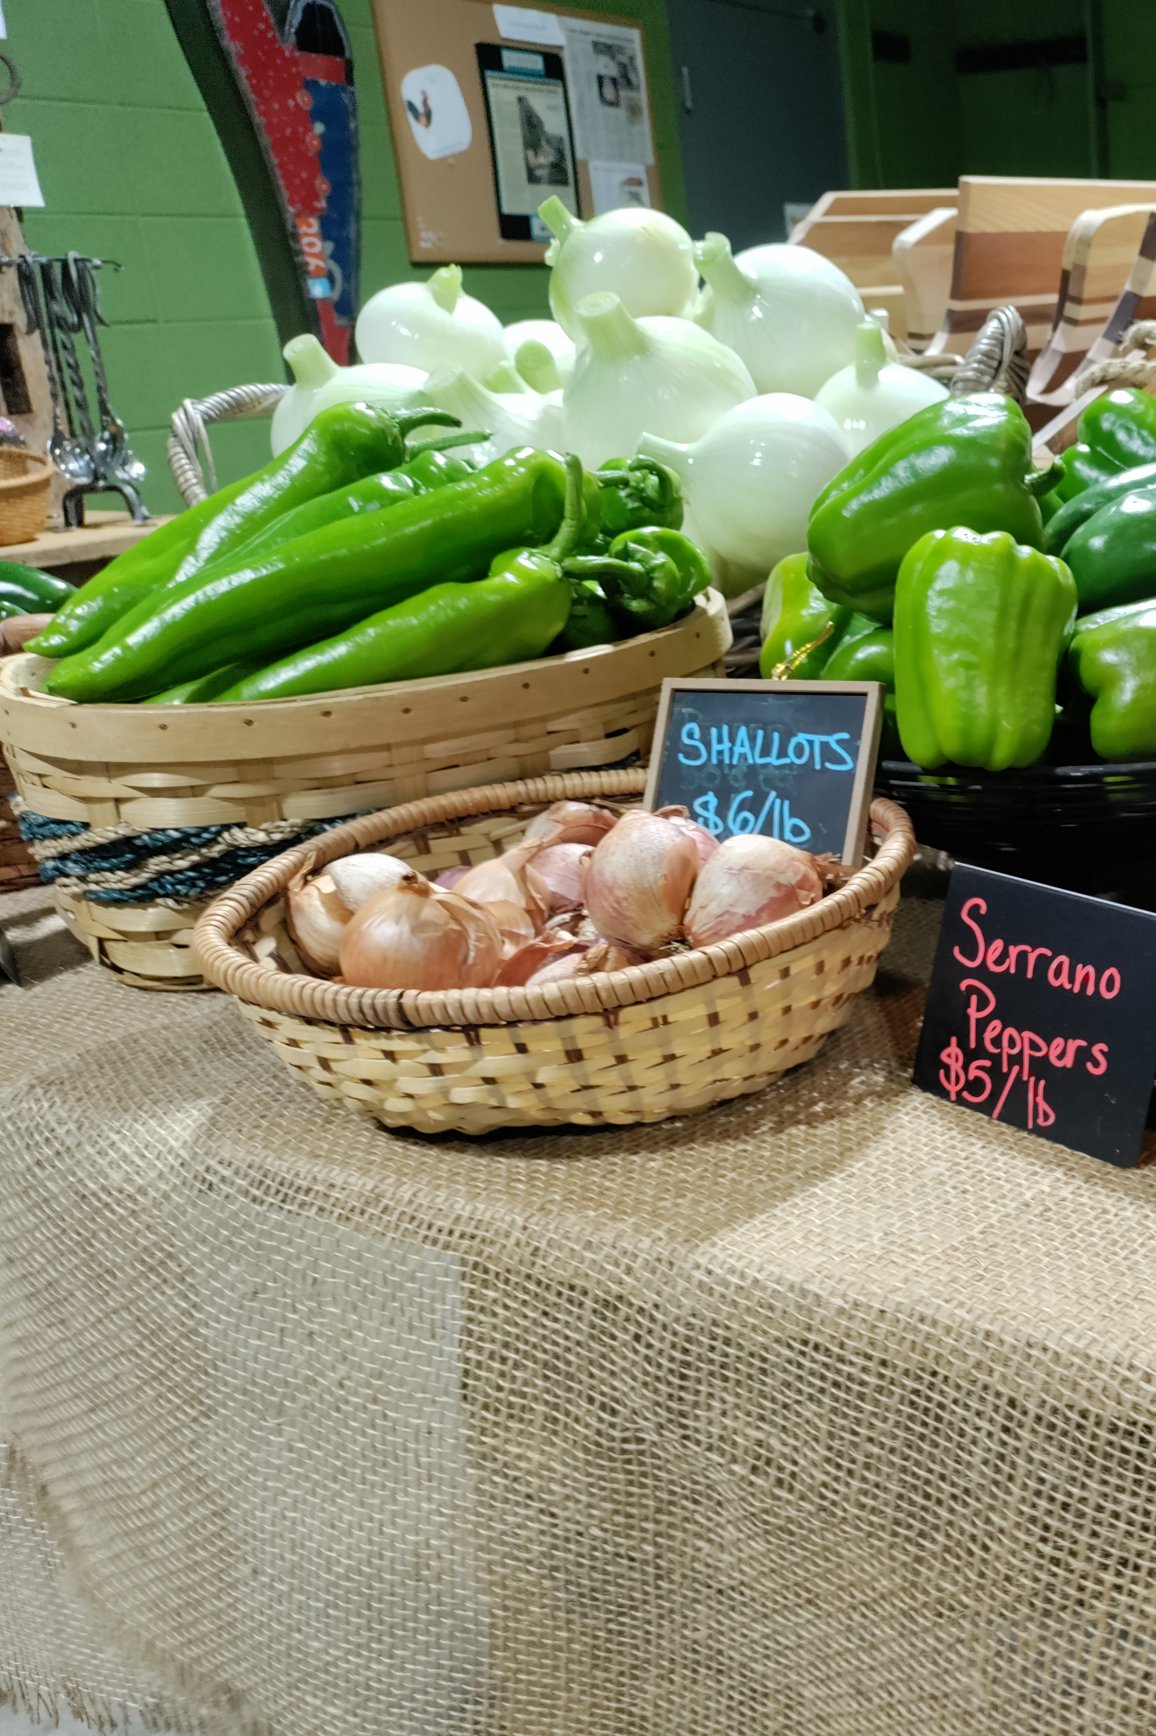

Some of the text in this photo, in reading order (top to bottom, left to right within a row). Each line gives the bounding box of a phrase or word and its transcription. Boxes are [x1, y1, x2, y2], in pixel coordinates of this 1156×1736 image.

[677, 721, 855, 772] SHALLOTS
[692, 789, 812, 844] $6/lb
[952, 896, 1122, 1000] Serrano
[959, 978, 1109, 1081] Peppers
[938, 1035, 1056, 1129] $5/lb
